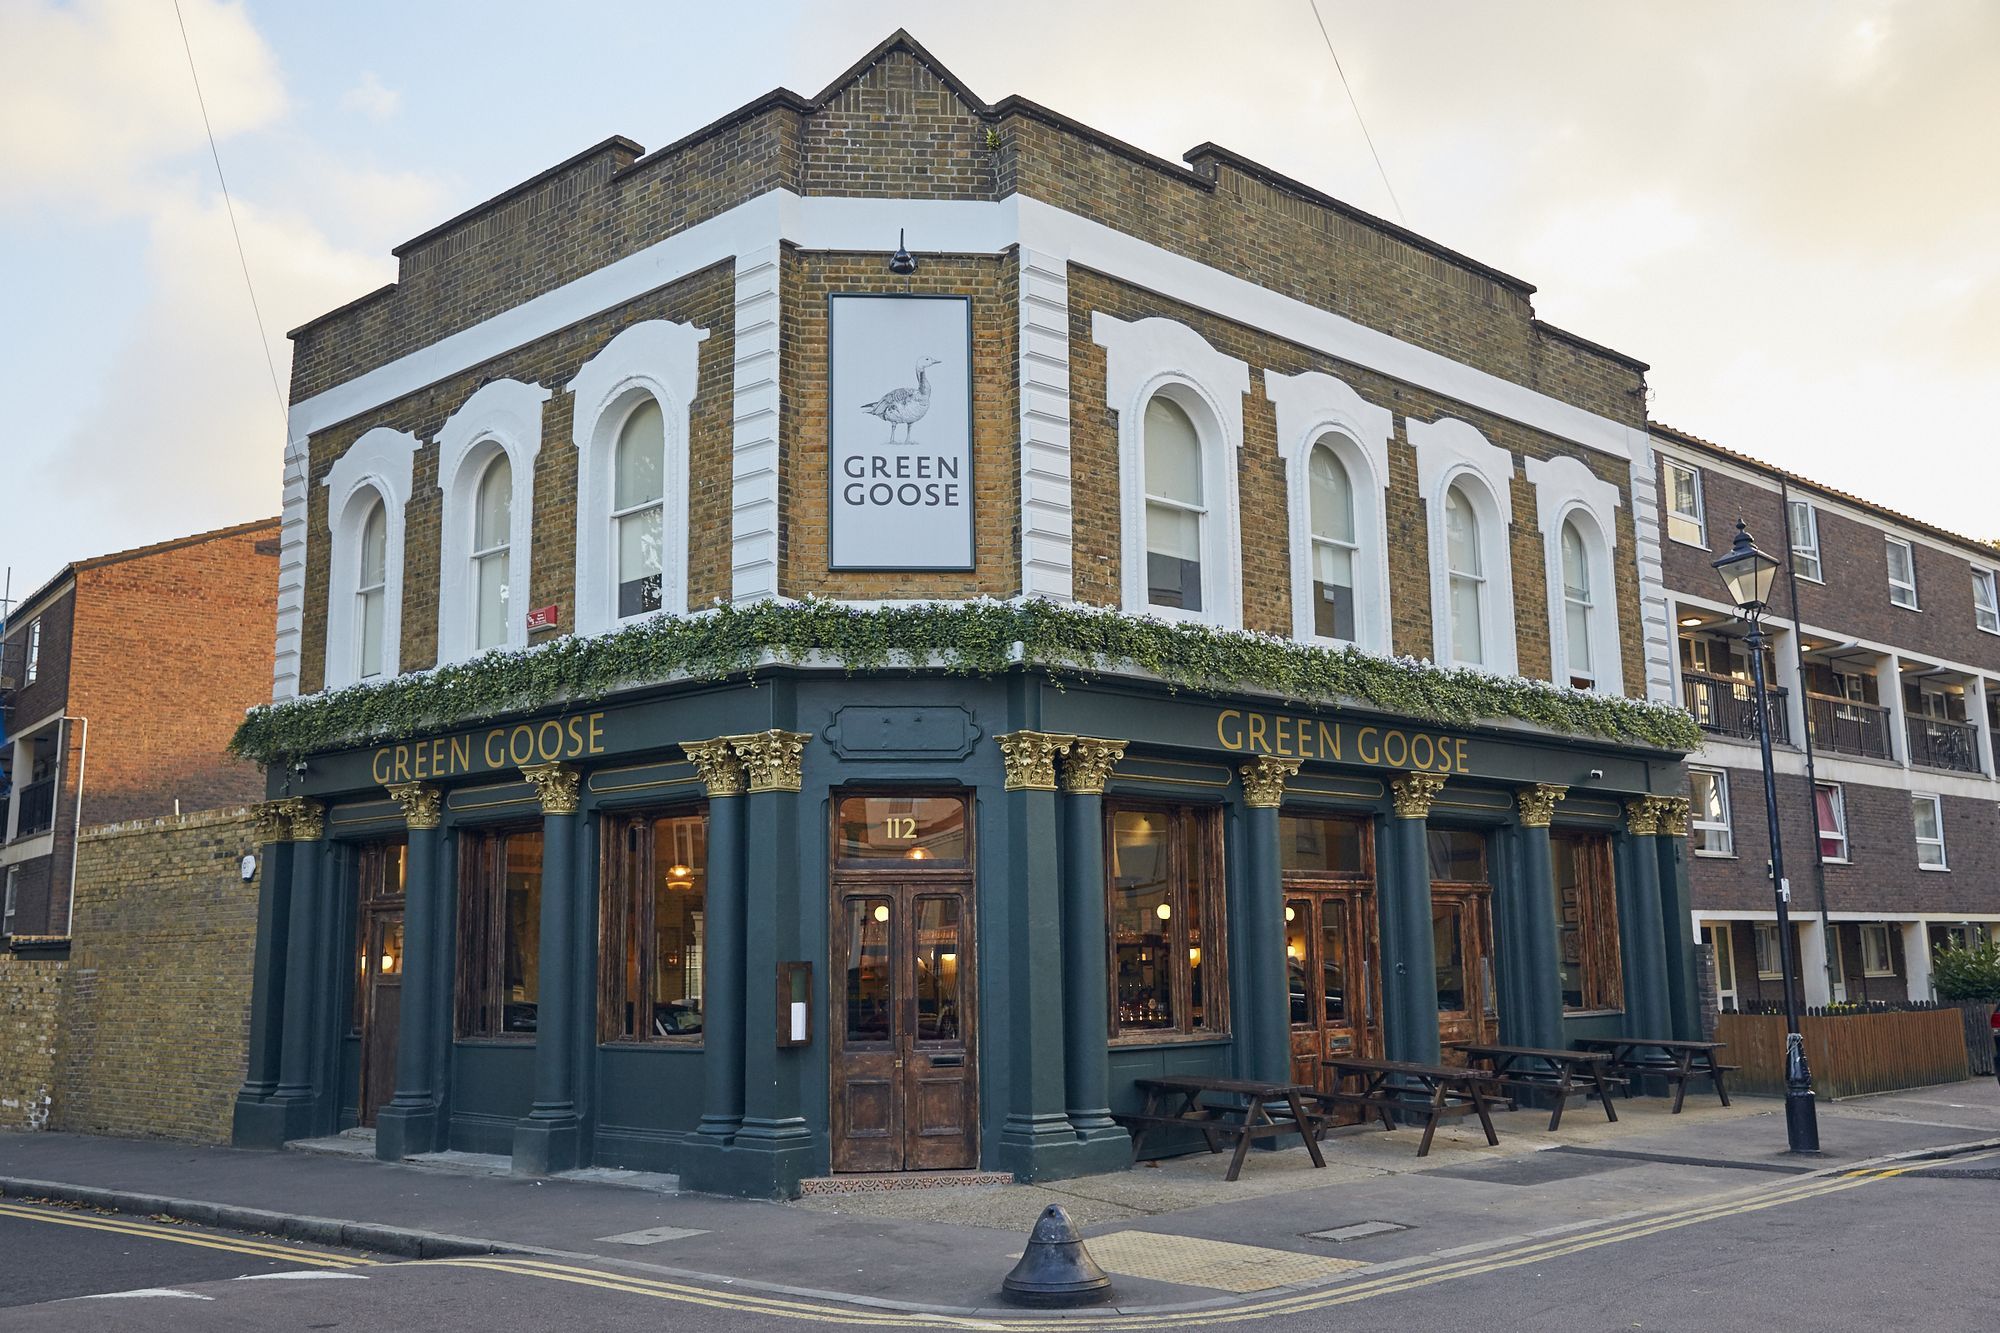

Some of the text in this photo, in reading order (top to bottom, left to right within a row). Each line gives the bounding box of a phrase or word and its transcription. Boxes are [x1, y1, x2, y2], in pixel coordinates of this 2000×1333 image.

[843, 455, 959, 479] GREEN
[843, 482, 959, 507] GOOSE
[372, 712, 605, 784] GREEN GOOSE
[1217, 709, 1470, 773] GREEN GOOSE
[886, 817, 917, 839] 112
